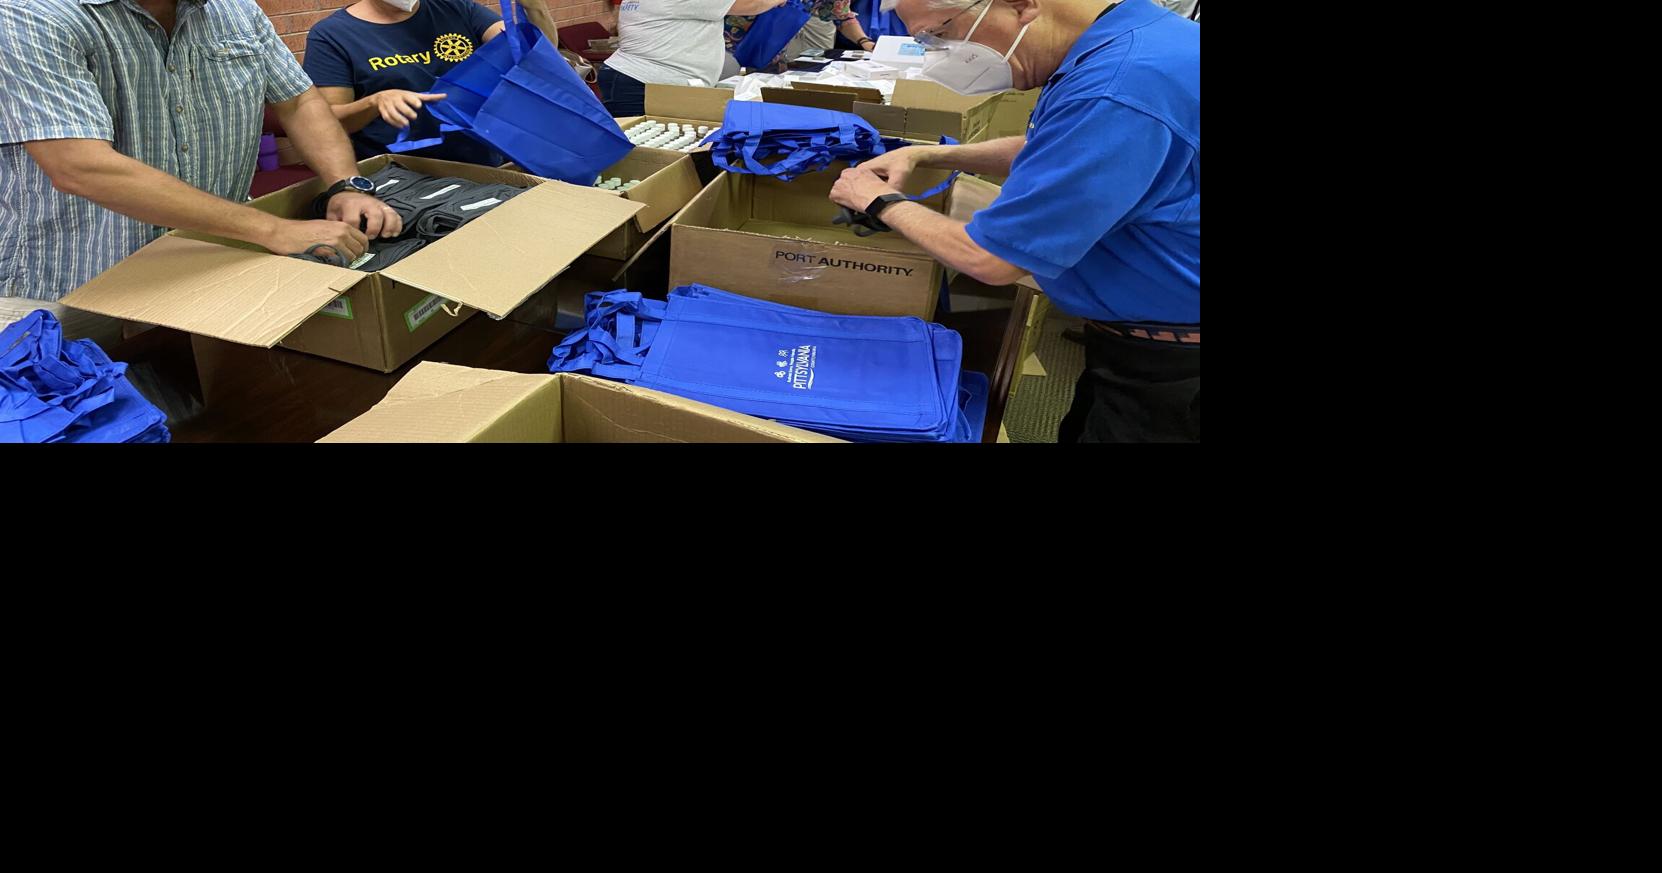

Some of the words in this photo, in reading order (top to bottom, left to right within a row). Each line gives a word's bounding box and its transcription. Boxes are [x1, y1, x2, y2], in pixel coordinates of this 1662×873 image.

[368, 51, 431, 71] Rotary
[775, 250, 816, 264] PORT
[793, 345, 811, 390] PITTSYLVANIA
